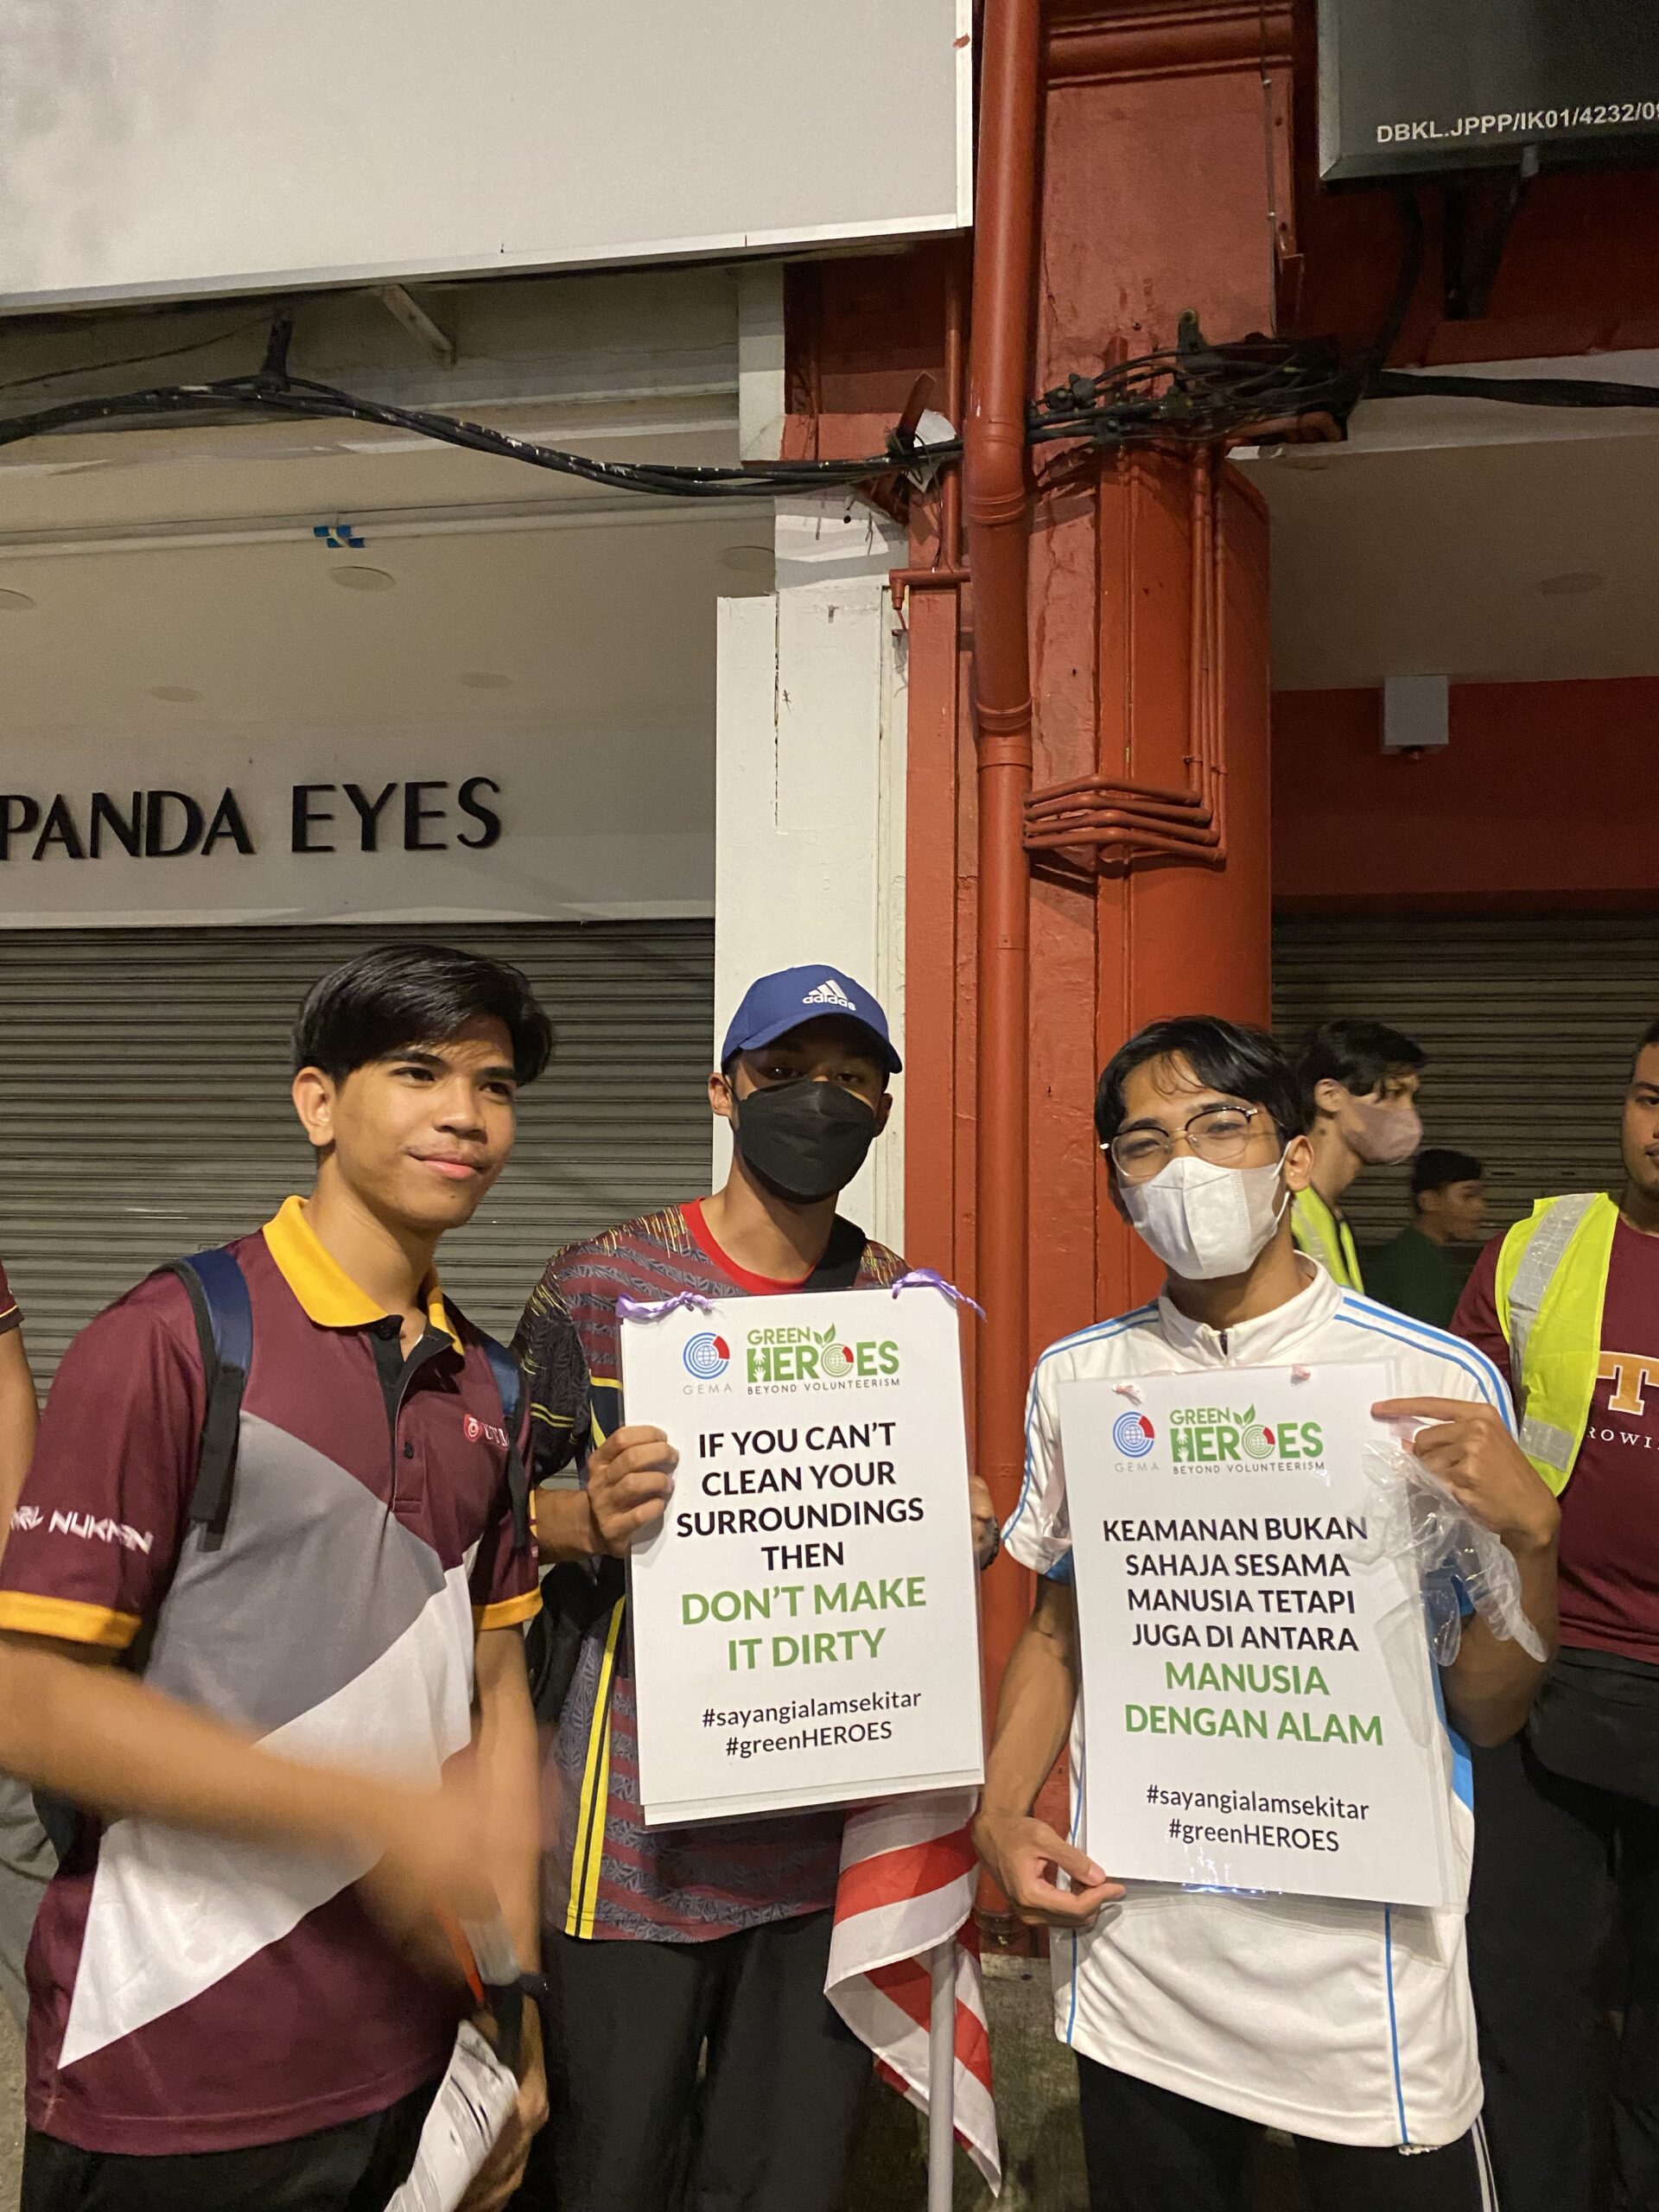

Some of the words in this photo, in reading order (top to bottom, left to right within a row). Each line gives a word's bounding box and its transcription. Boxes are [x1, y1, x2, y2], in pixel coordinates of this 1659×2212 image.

[1376, 102, 1659, 143] DBKL.JPPP/IK01/4232/0
[0, 788, 257, 861] PANDA
[291, 777, 504, 854] EYES
[802, 994, 857, 1011] adidas
[747, 1327, 810, 1345] GREEN
[747, 1340, 899, 1383] HEROES
[683, 1383, 733, 1395] GEMA
[747, 1383, 797, 1395] BEYOND
[804, 1378, 900, 1392] VOLUNTEERISM
[1170, 1408, 1230, 1425] GREEN
[699, 1433, 724, 1459] IF
[731, 1428, 798, 1455] YOU
[805, 1422, 896, 1450] CAN'T
[1170, 1421, 1324, 1462] HEROES
[702, 1467, 802, 1497] CLEAN
[810, 1460, 896, 1490] YOUR
[1115, 1463, 1160, 1473] GEMA
[1173, 1465, 1221, 1475] BEYOND
[1226, 1461, 1325, 1473] VOLUNTEERISM
[677, 1497, 924, 1537] SURROUNDINGS
[1103, 1518, 1258, 1541] KEAMANAN
[1265, 1516, 1368, 1541] BUKAN
[761, 1541, 844, 1571] THEN
[1126, 1554, 1230, 1577] SAHAJA
[1235, 1554, 1351, 1577] SESAMA
[682, 1585, 804, 1625] DON'T
[814, 1576, 926, 1614] MAKE
[1128, 1588, 1254, 1613] MANUSIA
[1258, 1590, 1355, 1613] TETAPI
[728, 1638, 763, 1671] IT
[772, 1627, 887, 1668] DIRTY
[1133, 1624, 1201, 1647] JUGA
[1205, 1625, 1233, 1648] DI
[1240, 1626, 1359, 1651] ANTARA
[1165, 1662, 1330, 1695] MANUSIA
[702, 1692, 922, 1727] #sayangialamsekitar
[1125, 1704, 1268, 1739] DENGAN
[1277, 1711, 1383, 1746] ALAM
[725, 1721, 893, 1758] #greenHEROES
[1147, 1783, 1369, 1820] #sayangialamsekitar
[1169, 1819, 1339, 1853] #greenHEROES
